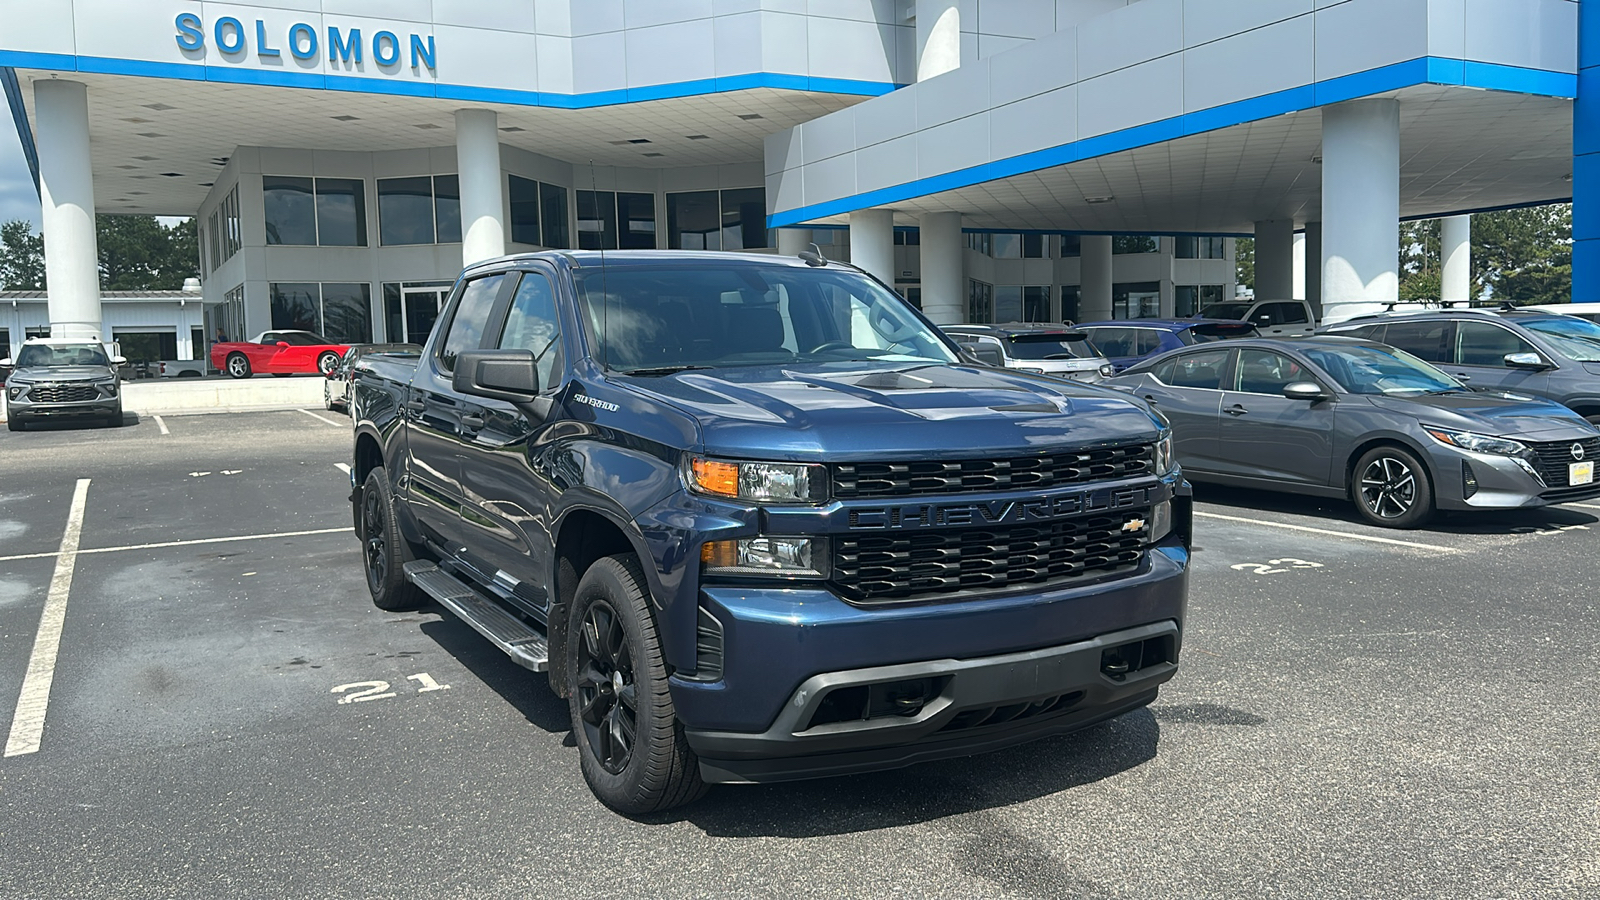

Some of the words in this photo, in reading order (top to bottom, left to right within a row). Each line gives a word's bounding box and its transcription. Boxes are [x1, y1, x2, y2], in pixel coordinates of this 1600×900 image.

[174, 12, 436, 70] SOLOMON
[849, 484, 1158, 530] CHEVROLET
[1230, 557, 1325, 575] 23
[330, 672, 451, 705] 21
